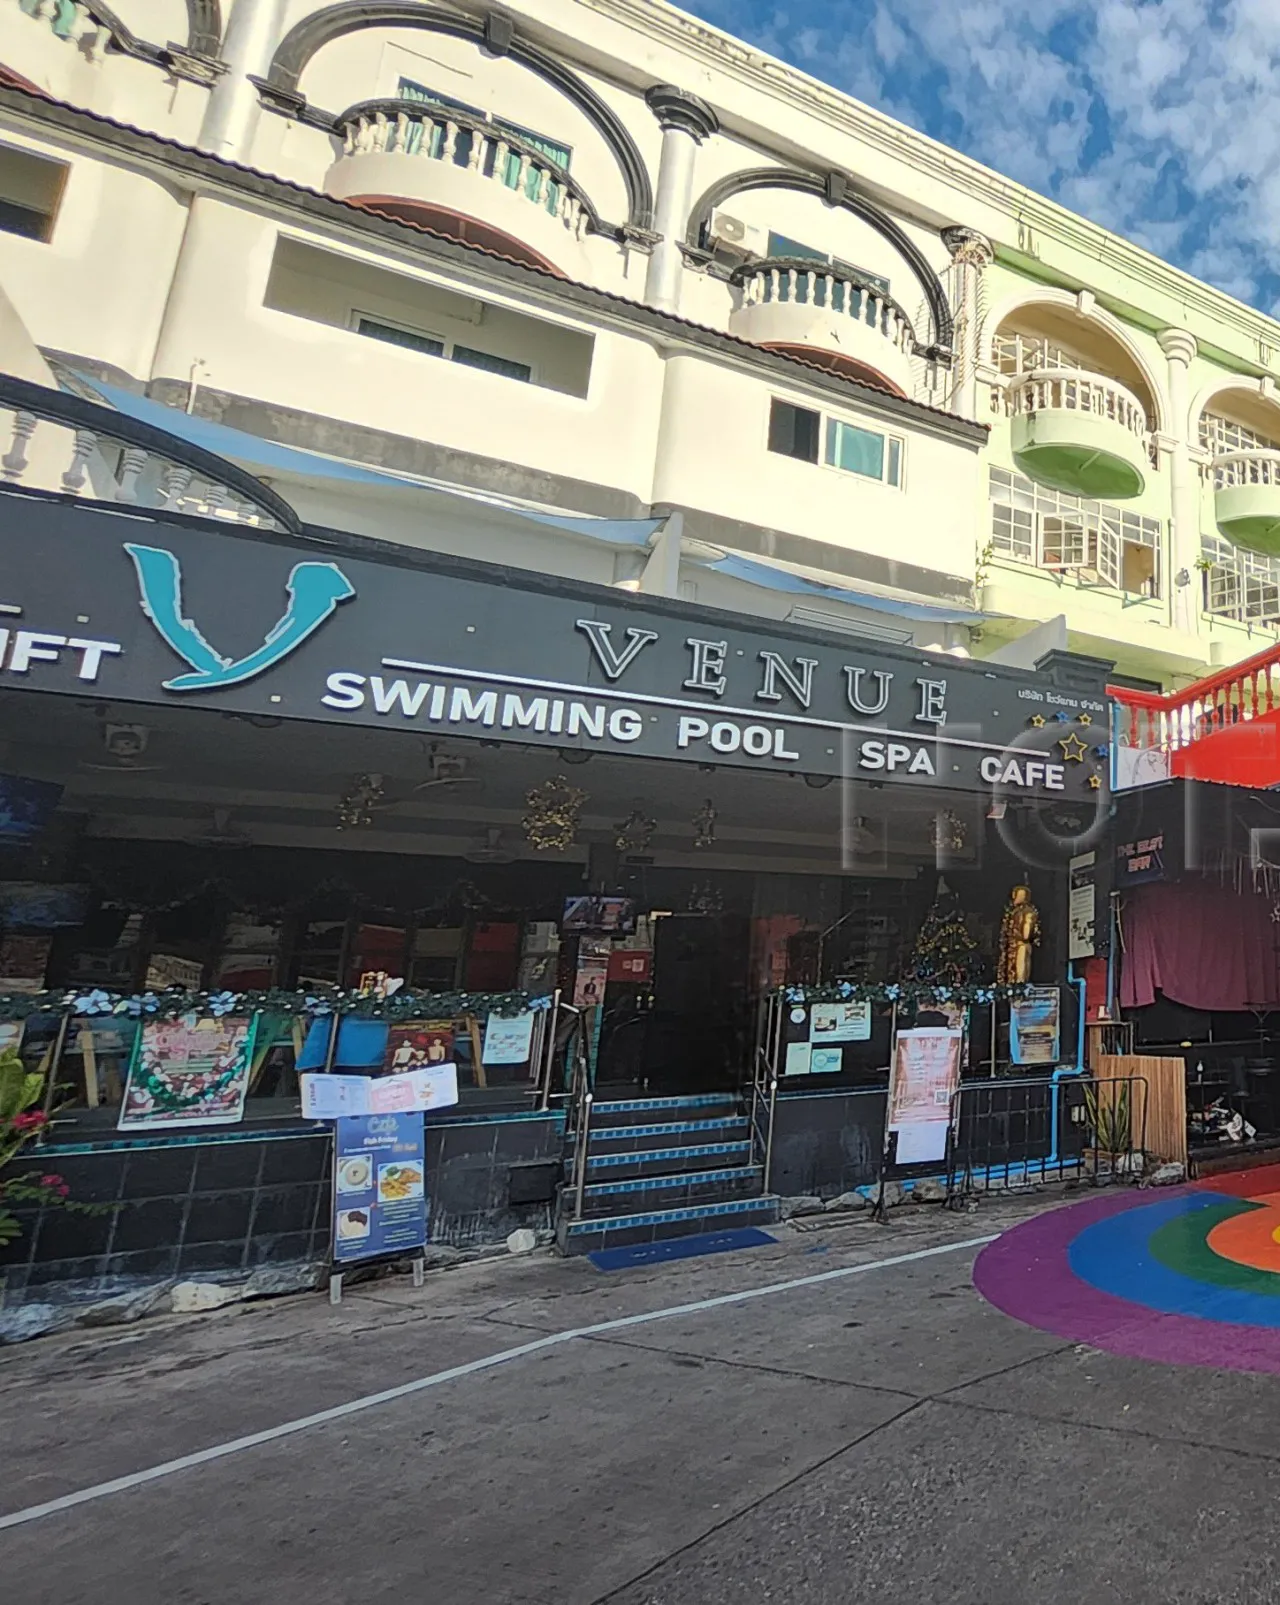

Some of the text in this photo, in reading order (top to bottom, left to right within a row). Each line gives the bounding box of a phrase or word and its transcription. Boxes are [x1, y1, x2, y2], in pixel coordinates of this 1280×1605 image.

[576, 619, 948, 727] VENUE
[321, 672, 1065, 791] SWIMMING POOL SPA CAFE
